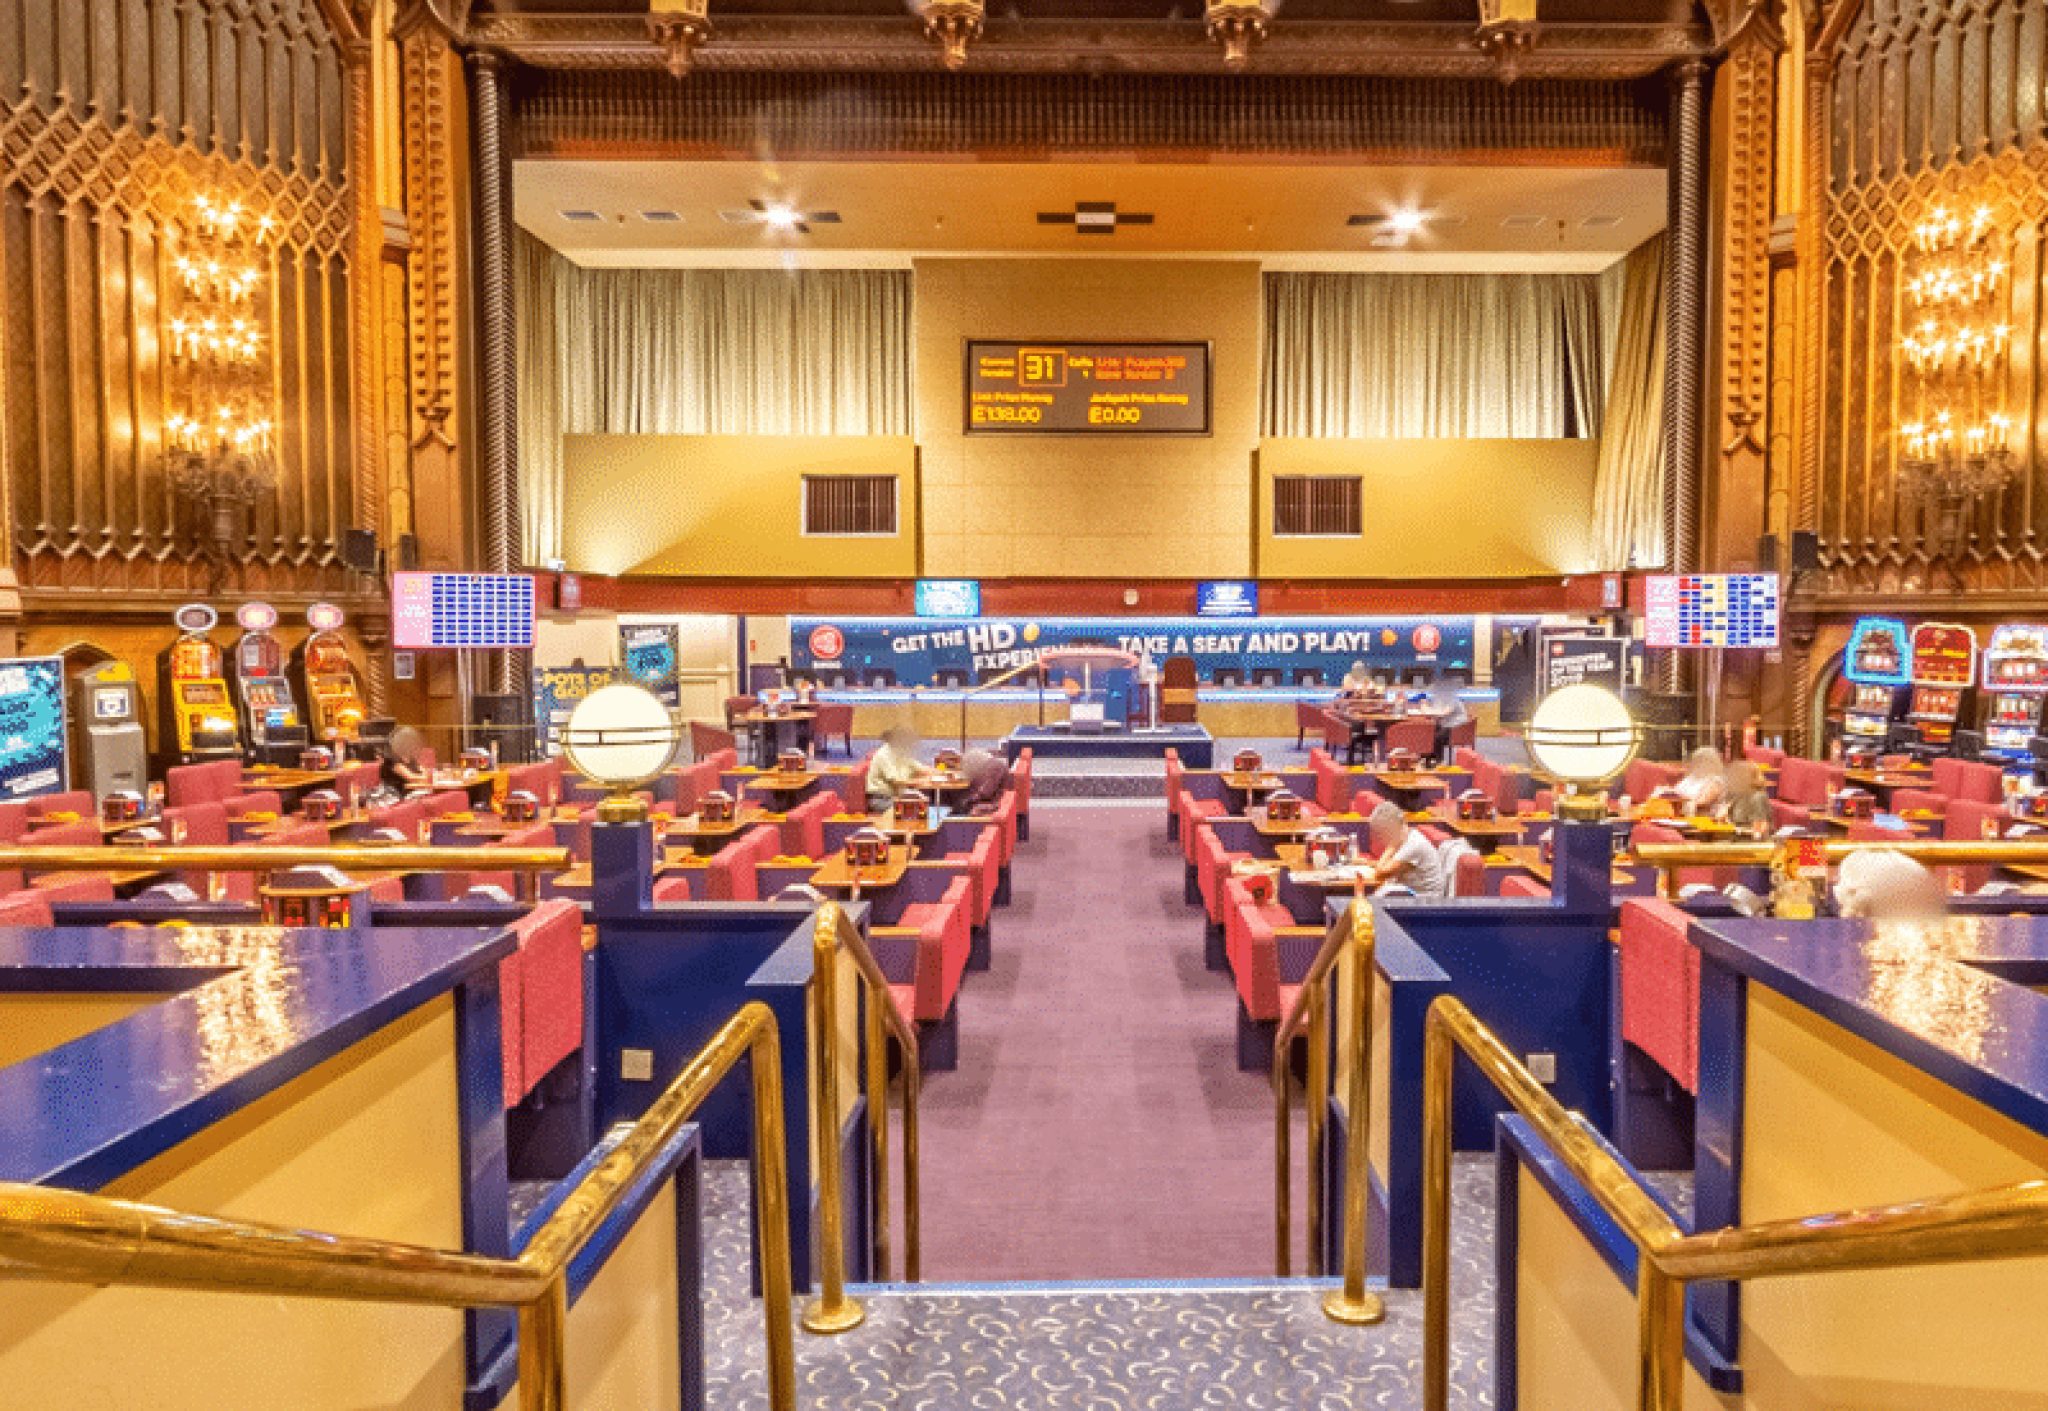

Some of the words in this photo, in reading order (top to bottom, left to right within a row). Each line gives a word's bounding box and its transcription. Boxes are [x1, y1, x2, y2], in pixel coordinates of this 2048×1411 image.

[1025, 355, 1054, 380] 31
[892, 634, 928, 654] GET
[931, 628, 966, 649] THE
[967, 622, 1017, 654] HD
[1118, 634, 1169, 655] TAKE
[1172, 636, 1190, 655] A
[1192, 634, 1244, 655] SEAT
[1246, 632, 1300, 654] AND
[1304, 630, 1371, 653] PLAY!
